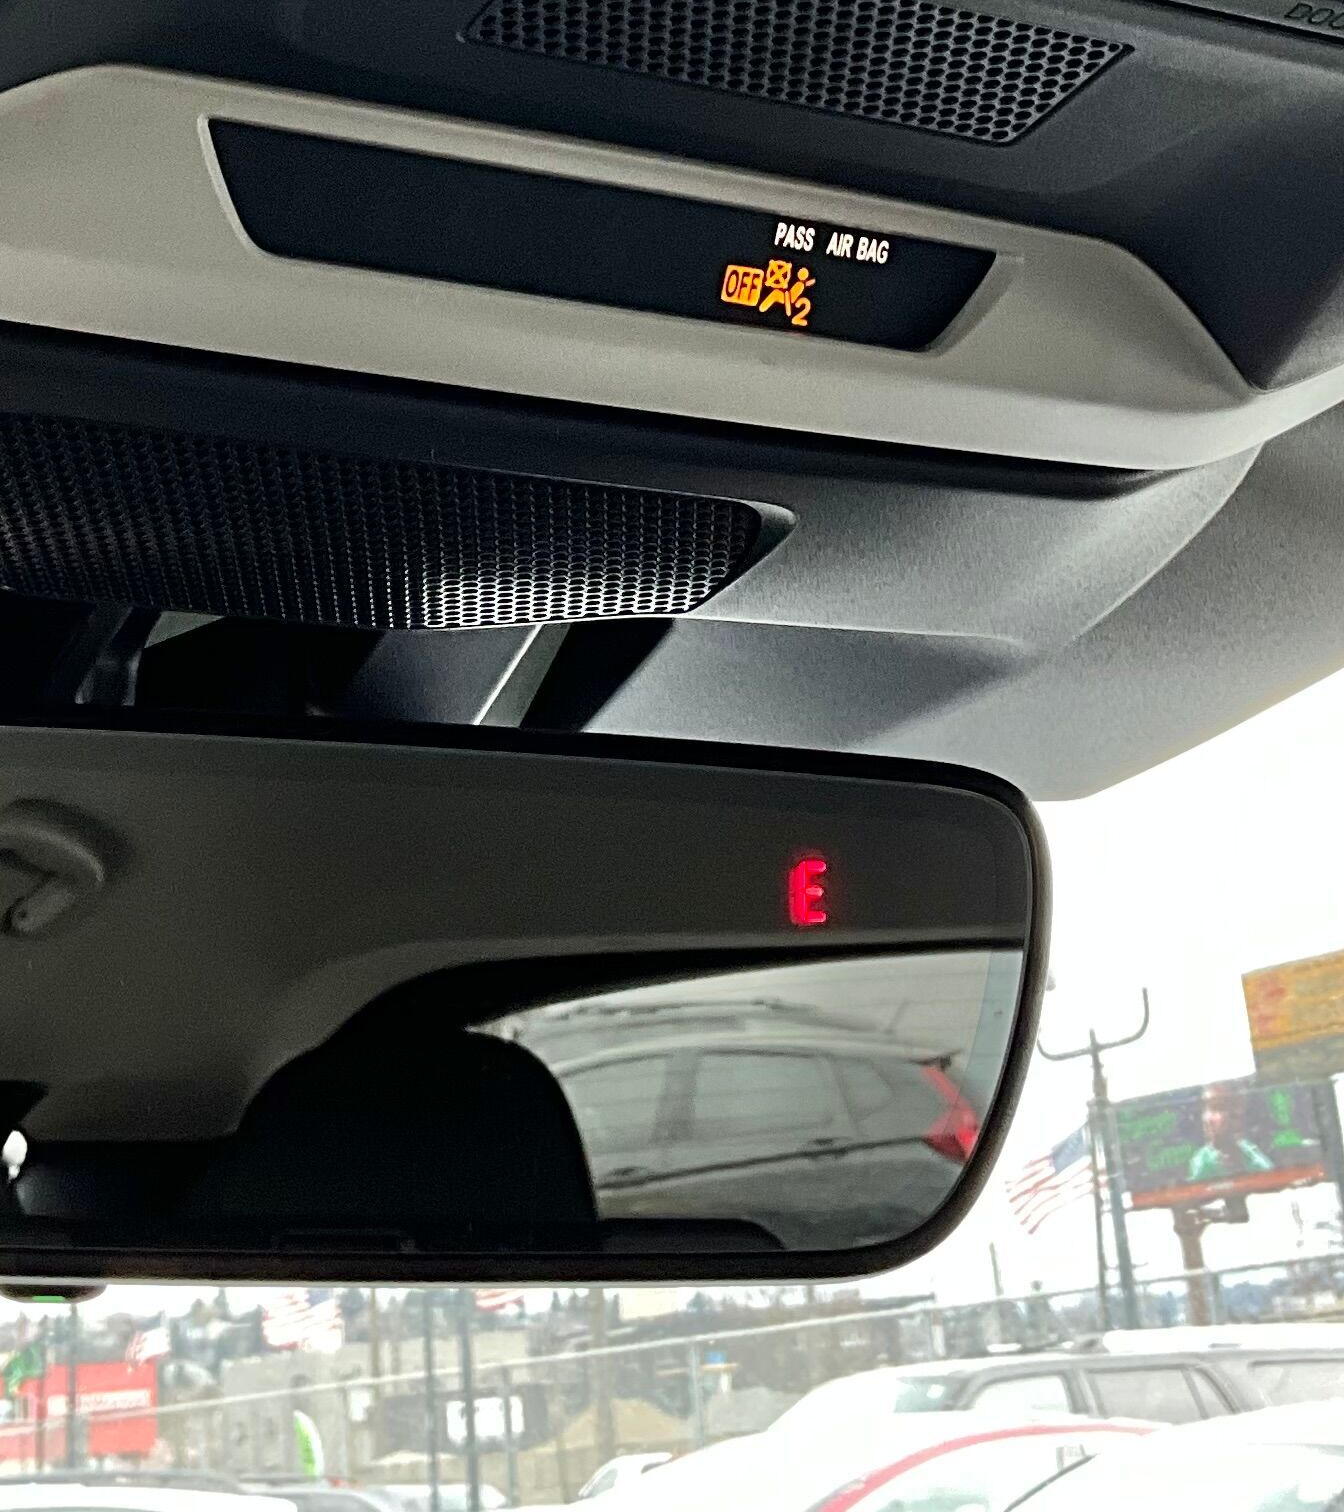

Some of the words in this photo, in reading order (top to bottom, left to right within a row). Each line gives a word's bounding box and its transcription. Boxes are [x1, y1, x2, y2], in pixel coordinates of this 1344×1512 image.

[774, 222, 816, 252] PASS
[826, 231, 854, 259] AIR
[856, 236, 890, 264] BAG
[726, 269, 761, 302] OFF
[788, 859, 827, 926] E
